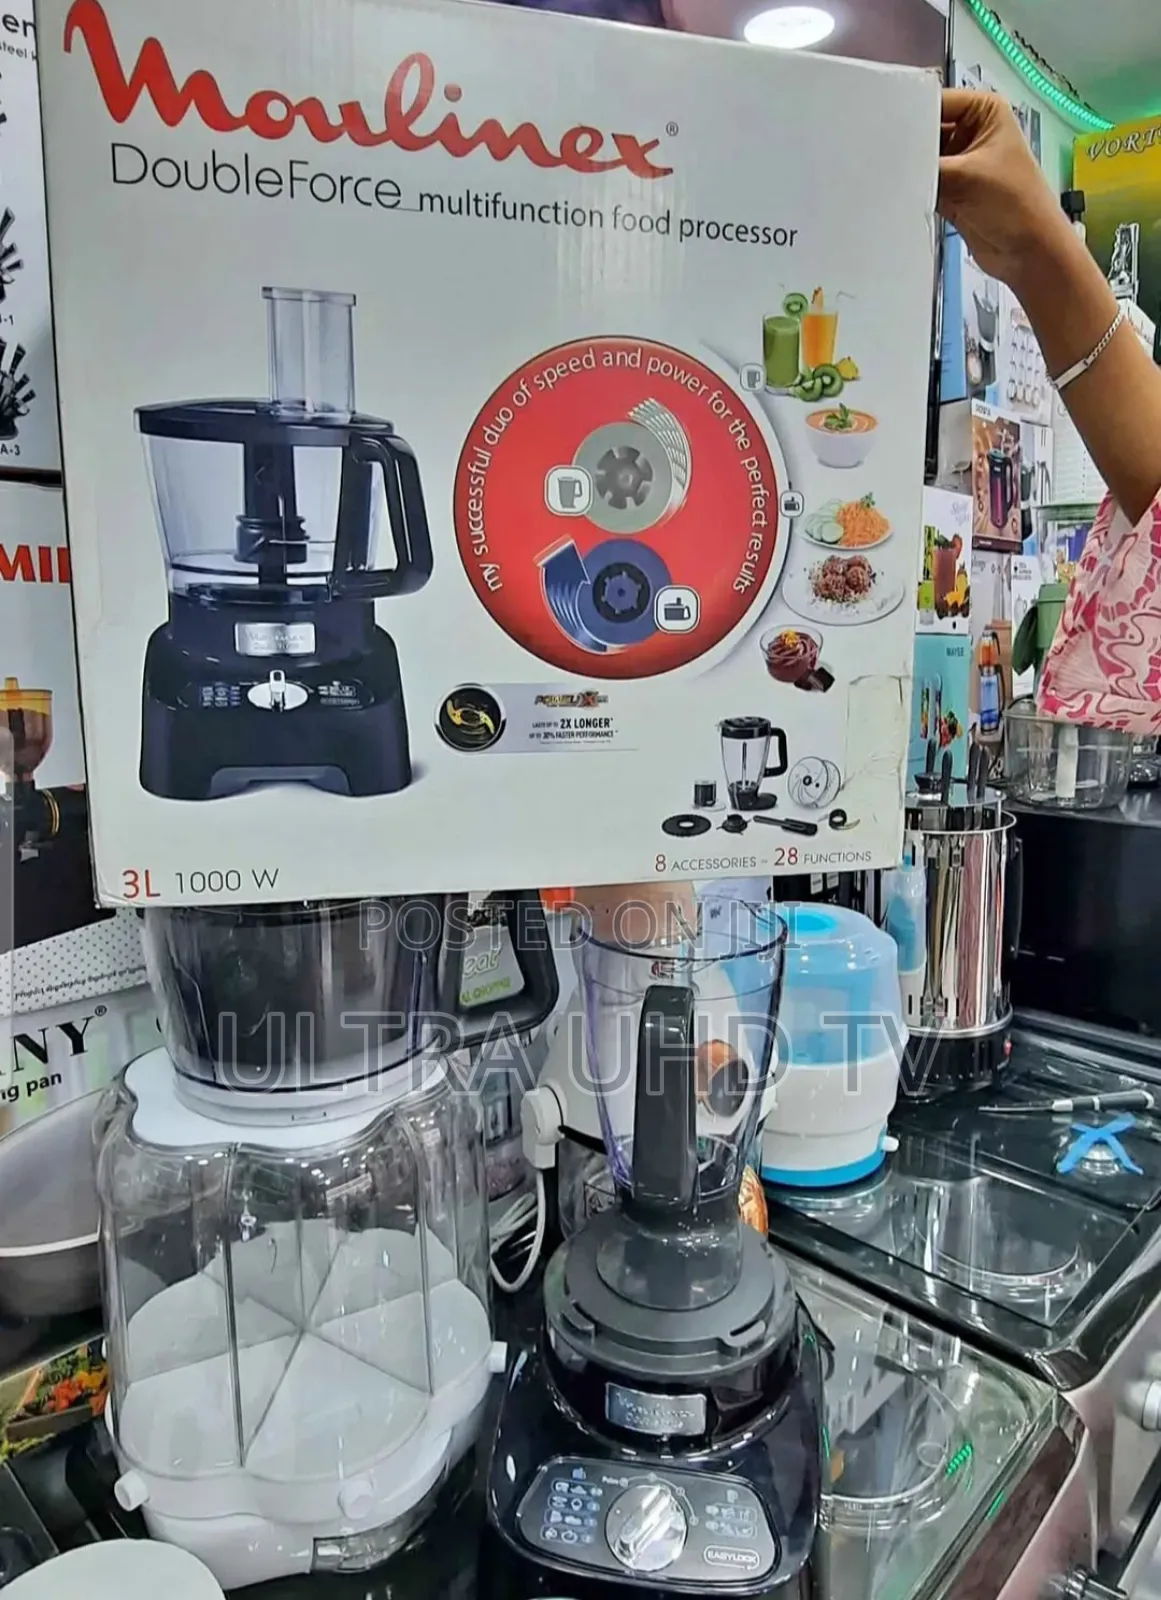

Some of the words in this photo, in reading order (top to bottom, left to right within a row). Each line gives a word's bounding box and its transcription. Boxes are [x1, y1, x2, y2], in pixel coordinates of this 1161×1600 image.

[111, 143, 402, 209] DoubleForce
[419, 190, 603, 229] multifunction
[613, 206, 671, 236] food
[679, 216, 799, 247] processor
[533, 348, 597, 391] speed
[602, 347, 642, 368] and
[647, 356, 709, 396] power
[513, 380, 533, 408] of
[707, 390, 733, 420] for
[483, 406, 514, 446] duo
[729, 417, 751, 451] the
[468, 447, 493, 556] successful
[740, 455, 770, 529] perfect
[479, 562, 503, 592] my
[732, 532, 764, 595] results
[560, 718, 572, 729] 2X
[655, 854, 667, 872] 8
[671, 856, 757, 872] ACCESSORIES
[774, 847, 799, 867] 28
[803, 851, 872, 865] FUNCTIONS
[122, 869, 161, 899] 3L
[176, 870, 242, 894] 1000
[252, 868, 279, 890] W
[26, 1072, 62, 1096] pan
